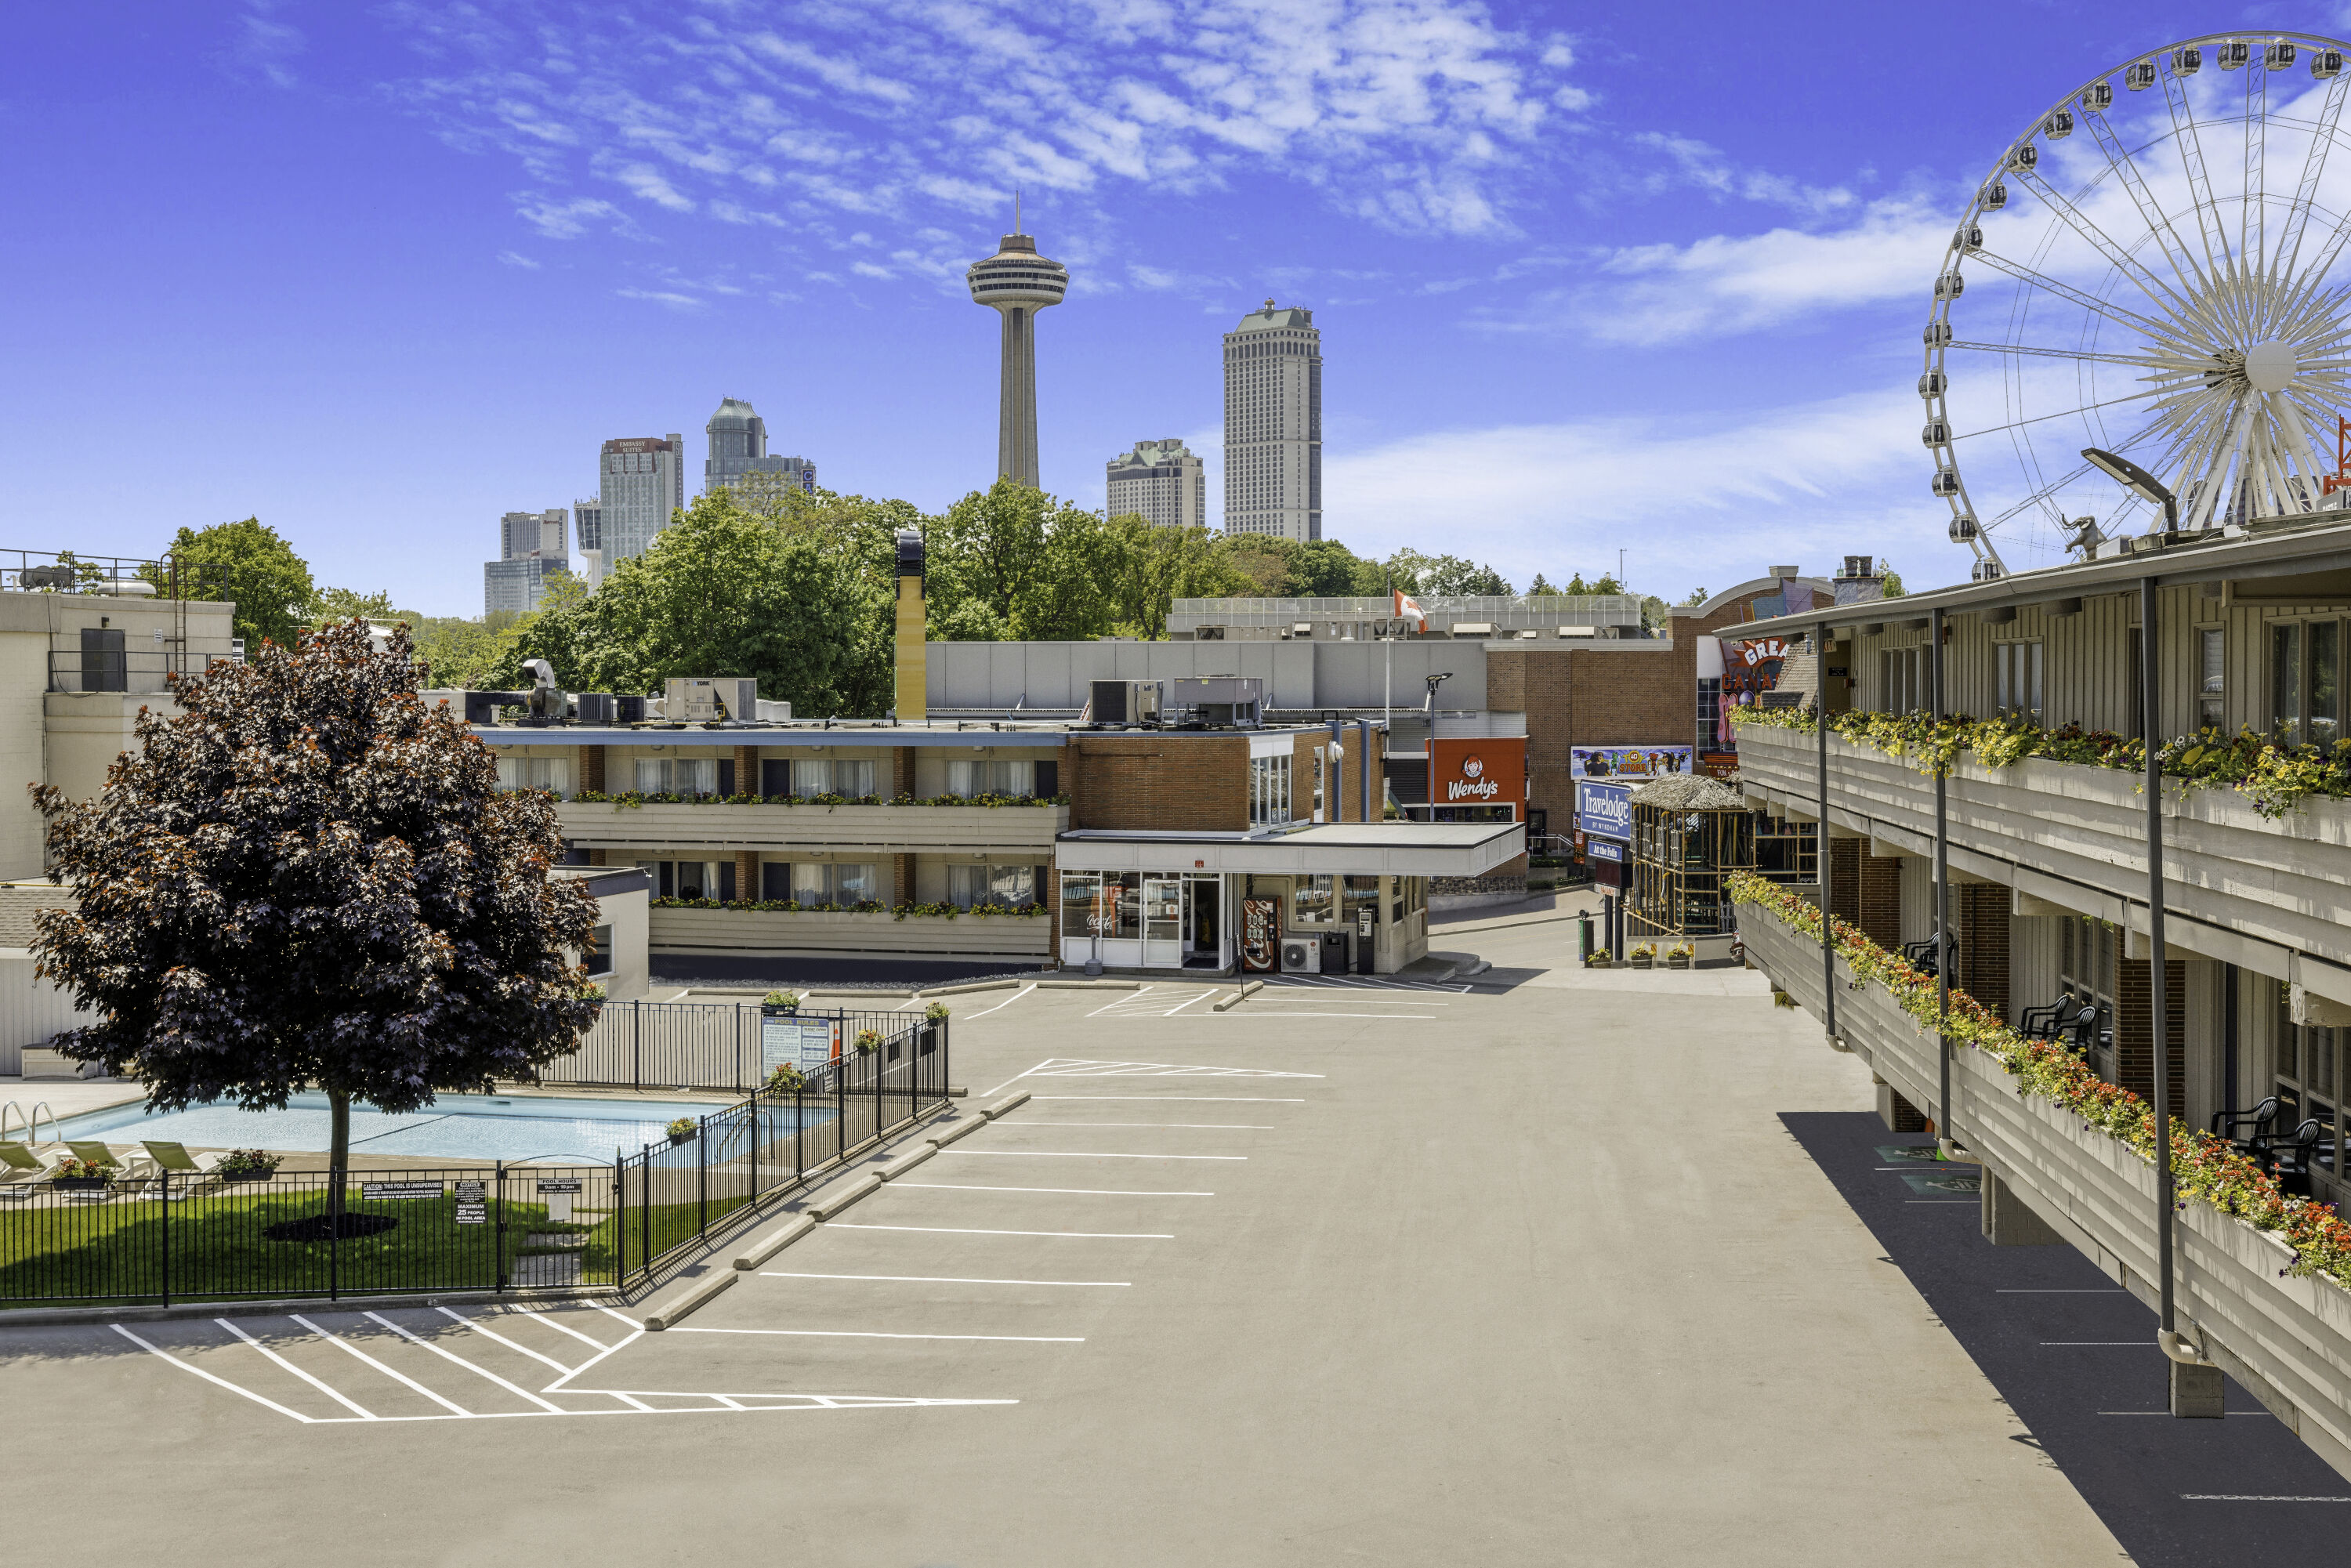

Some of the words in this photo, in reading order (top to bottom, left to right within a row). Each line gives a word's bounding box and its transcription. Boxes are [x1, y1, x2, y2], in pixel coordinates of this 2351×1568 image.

[1744, 639, 1790, 666] GREA
[1722, 673, 1780, 690] CANA
[1619, 763, 1647, 773] STORE
[1448, 777, 1498, 801] Wendy's
[1584, 787, 1628, 827] Travelodge
[1598, 822, 1618, 833] WYNDHAM
[1593, 845, 1599, 854] At
[1607, 847, 1617, 858] Falls
